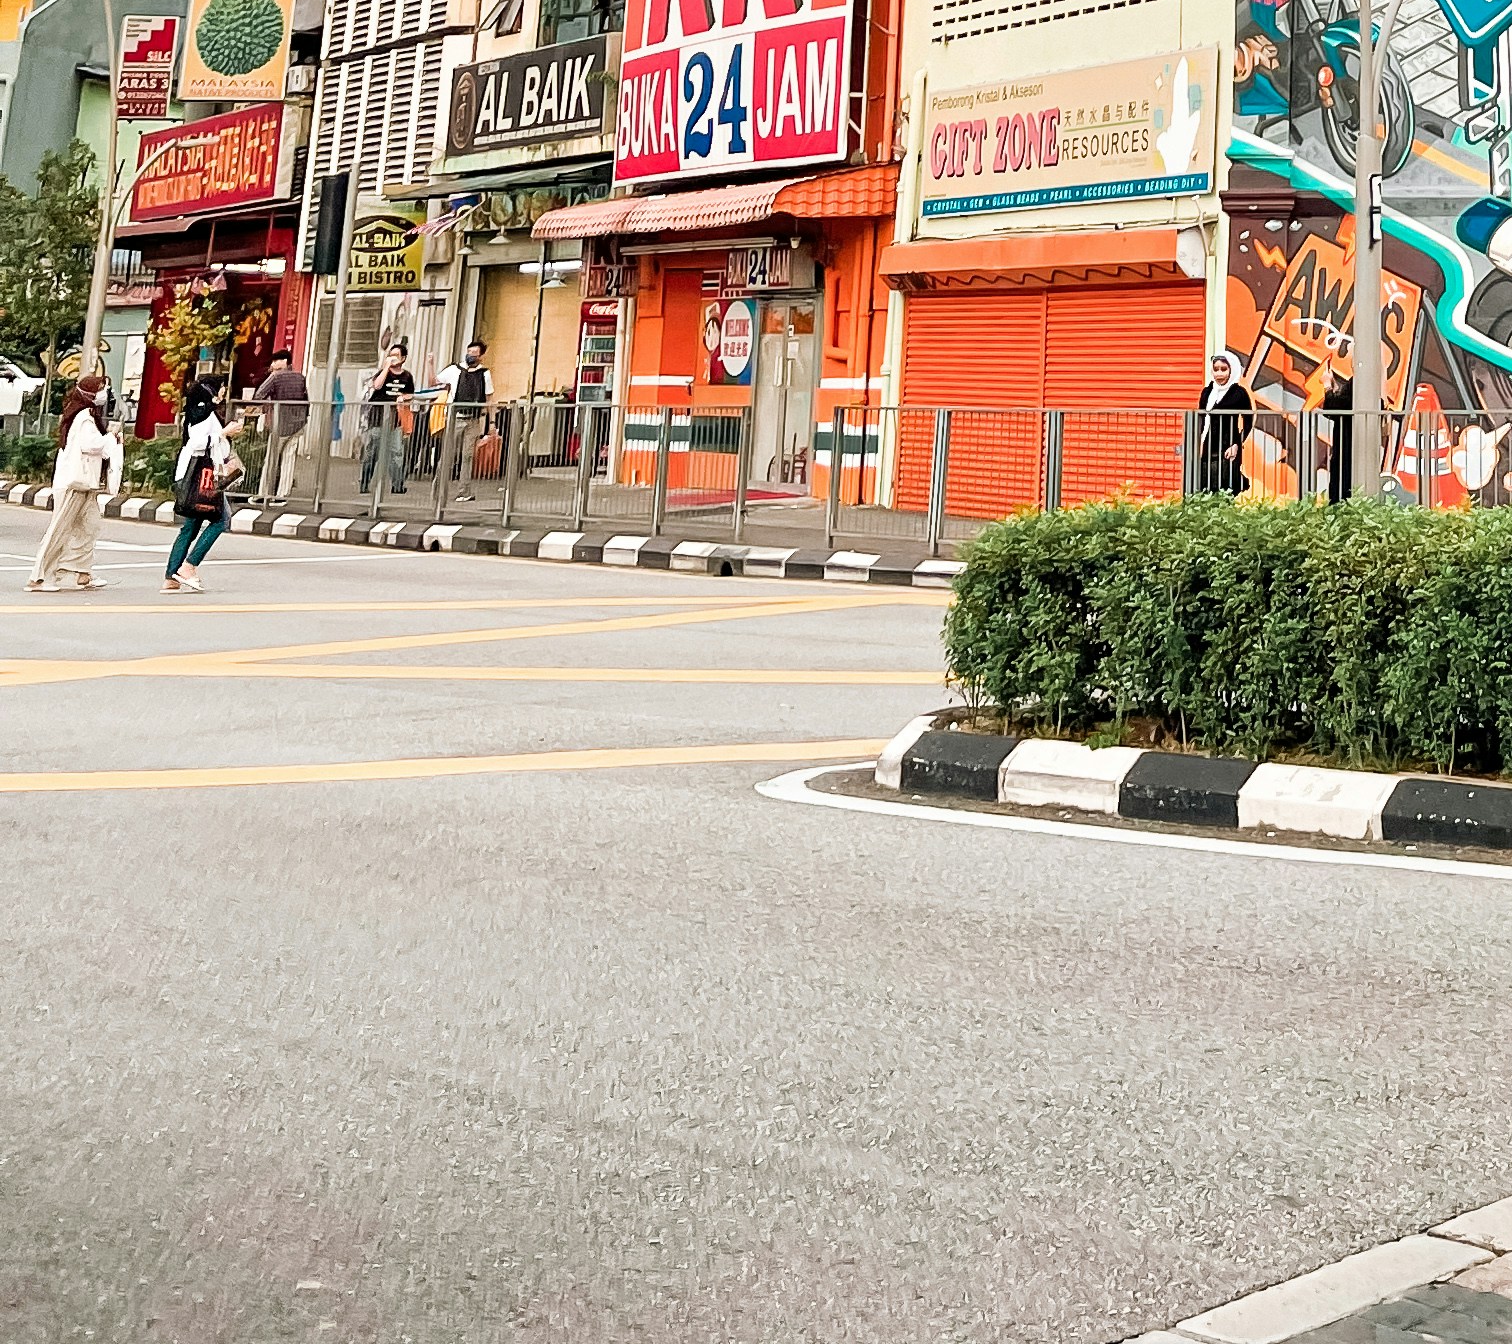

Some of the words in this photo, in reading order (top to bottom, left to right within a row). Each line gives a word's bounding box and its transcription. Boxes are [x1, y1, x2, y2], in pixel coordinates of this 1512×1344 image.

[119, 78, 158, 89] ARAS
[161, 78, 169, 89] 3
[191, 79, 274, 87] MALAYSIA
[475, 72, 512, 134] AL
[519, 54, 595, 127] BAIK
[619, 68, 676, 160] BUKA
[683, 43, 747, 160] 24
[757, 38, 838, 139] JAM
[931, 118, 987, 179] GIFT
[993, 107, 1060, 173] ZONE
[1062, 129, 1149, 161] RESOURCES
[992, 195, 1014, 206] GLASS
[1050, 189, 1072, 200] PEARL
[1082, 183, 1133, 197] ACCESSORIES
[1145, 179, 1178, 191] BEADING
[350, 255, 363, 268] L
[368, 254, 406, 267] BAIK
[748, 248, 767, 285] 24
[358, 270, 416, 285] BISTRO
[1275, 250, 1404, 380] AWS
